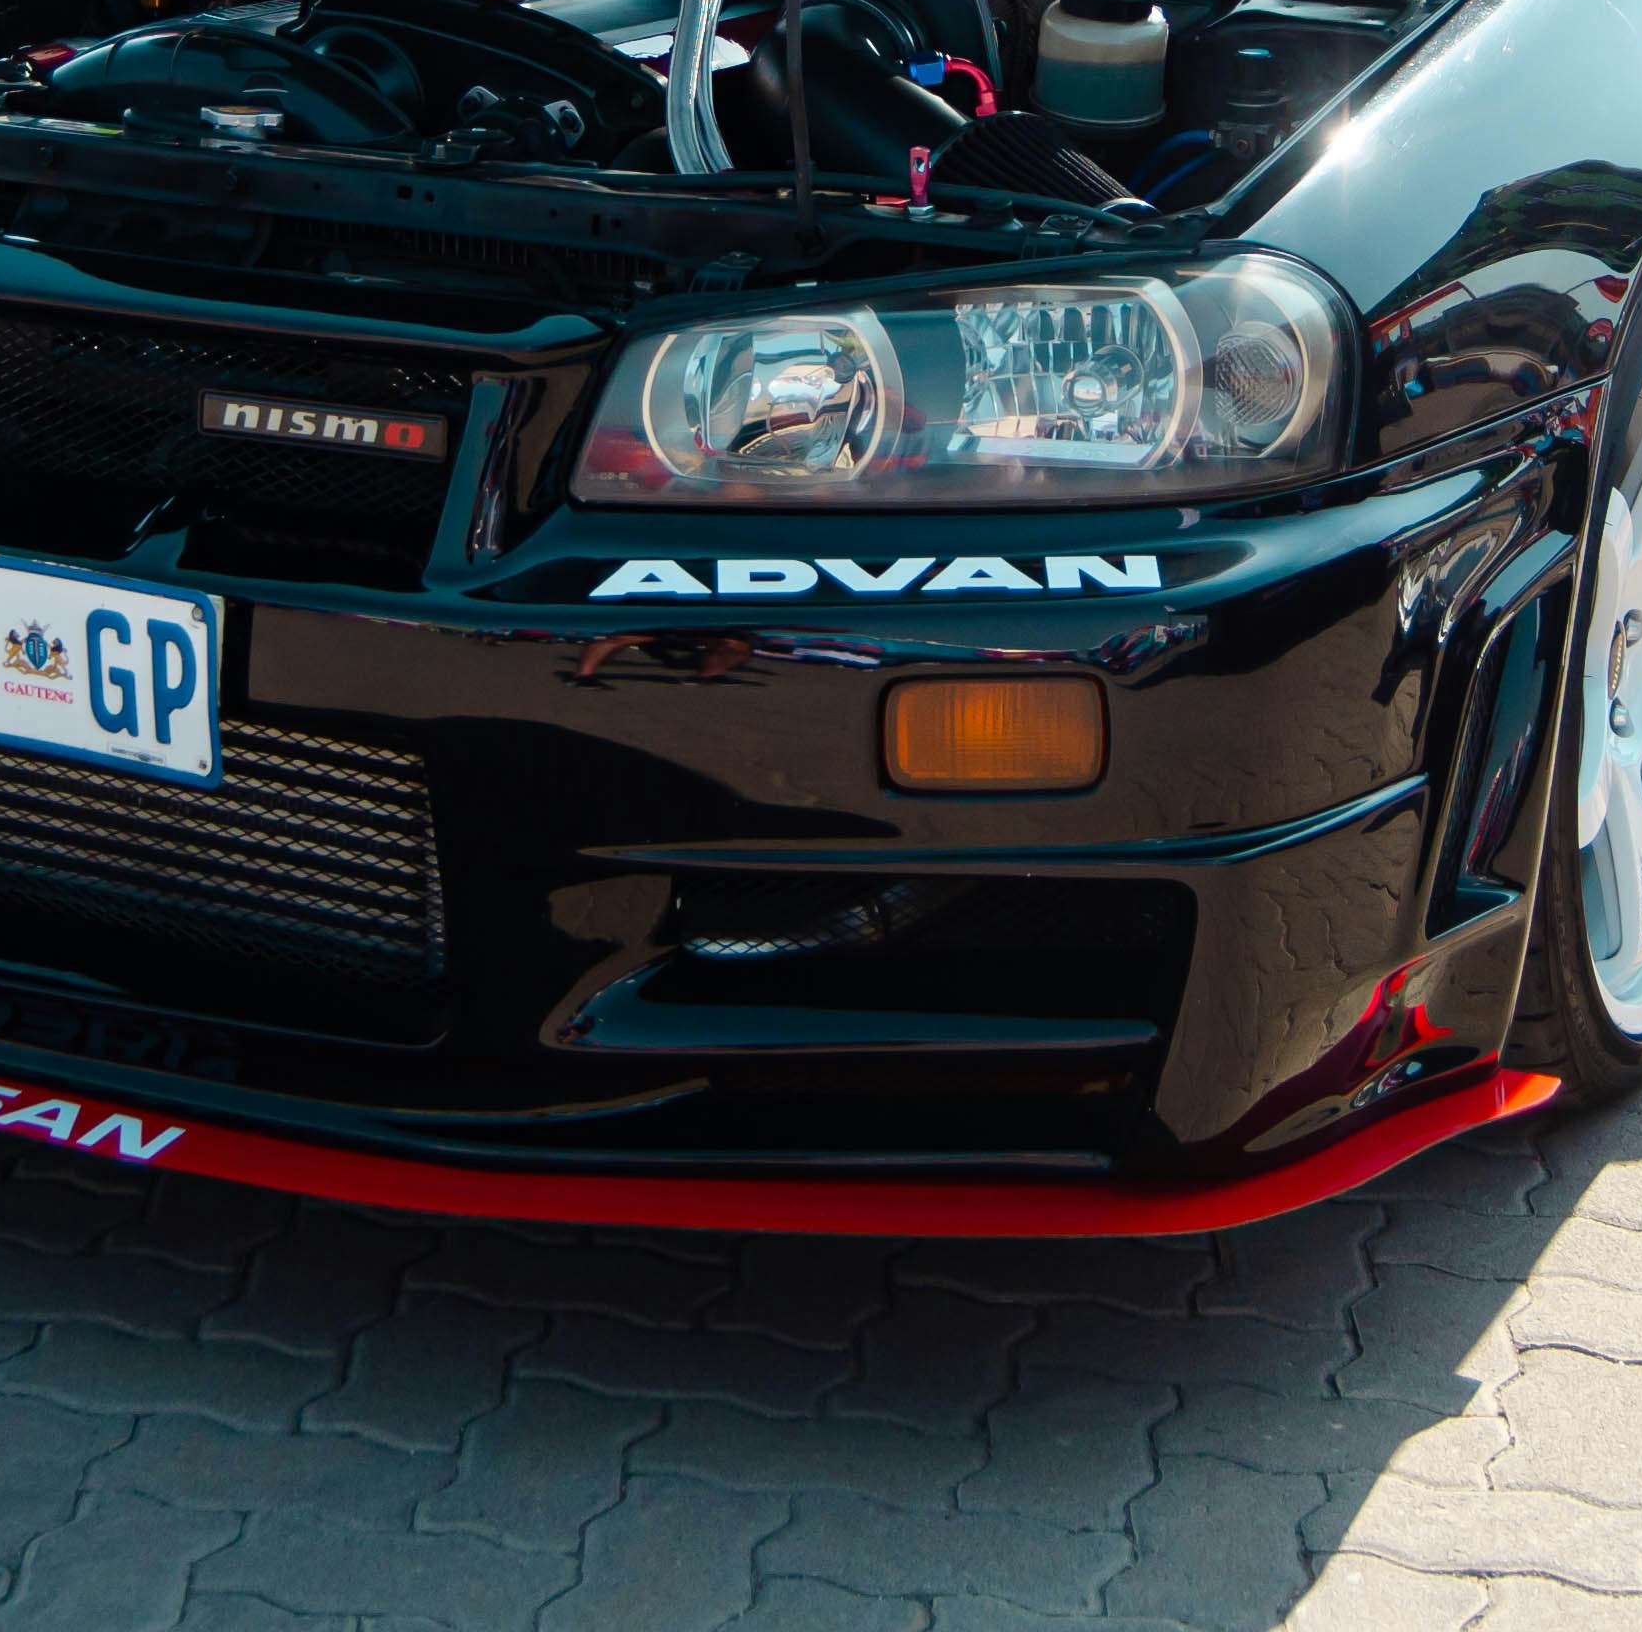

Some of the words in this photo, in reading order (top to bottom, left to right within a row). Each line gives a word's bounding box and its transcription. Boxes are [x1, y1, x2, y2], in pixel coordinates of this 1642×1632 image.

[223, 399, 425, 450] nismo
[589, 555, 1161, 597] ADVAN
[3, 680, 75, 705] GAUTENG
[85, 608, 198, 744] GP
